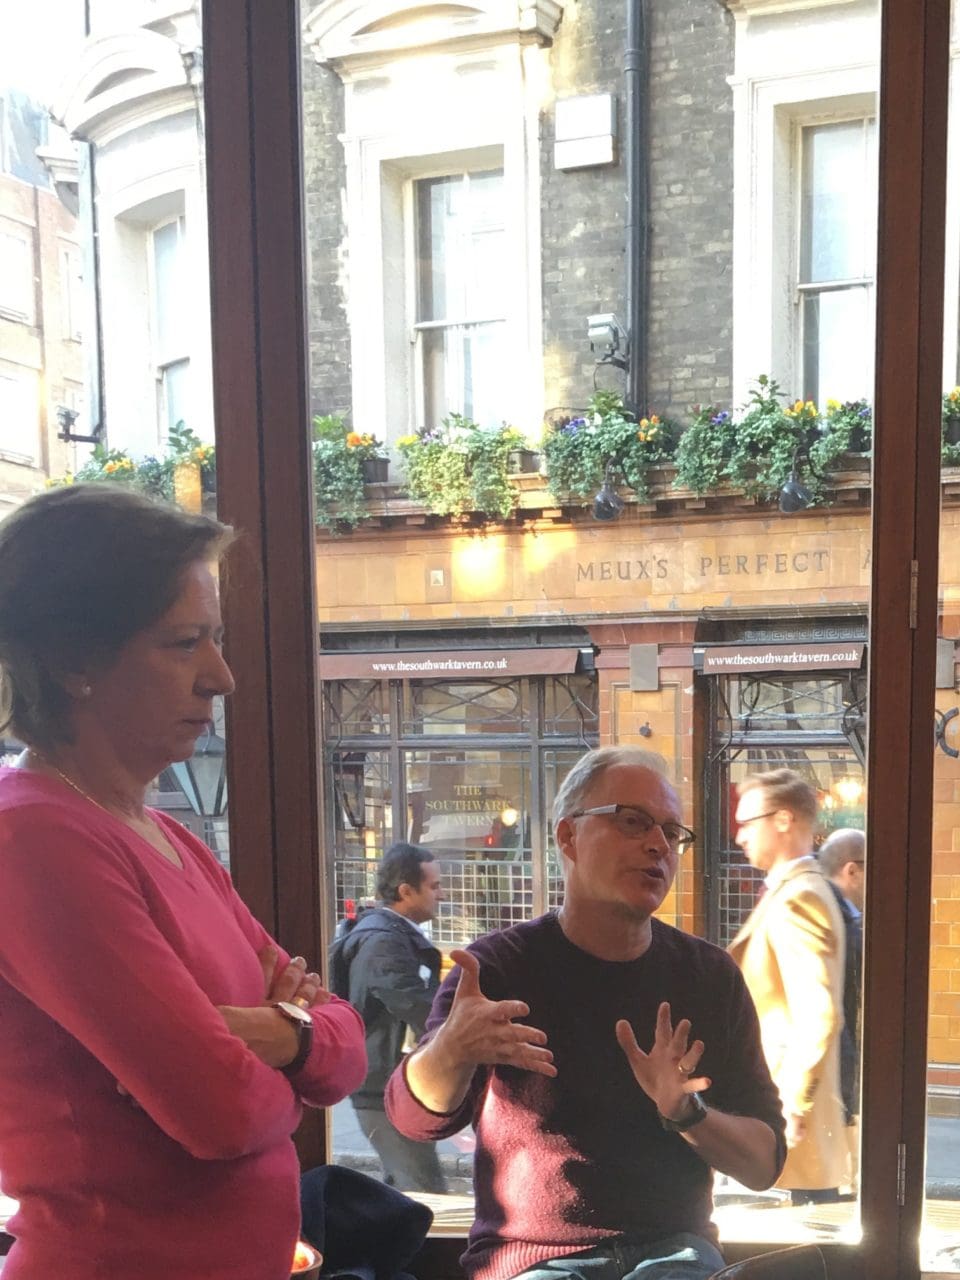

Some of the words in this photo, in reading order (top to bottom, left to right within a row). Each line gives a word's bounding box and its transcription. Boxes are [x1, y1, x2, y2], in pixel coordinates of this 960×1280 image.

[577, 556, 669, 582] MEUX'S
[700, 551, 830, 577] PERFECT
[372, 657, 508, 671] www.thesouthwarktavern.co.uk
[707, 649, 859, 666] www.thesouthwarktavern.co.uk
[453, 785, 482, 796] THE
[425, 801, 511, 812] SOUTHWARK
